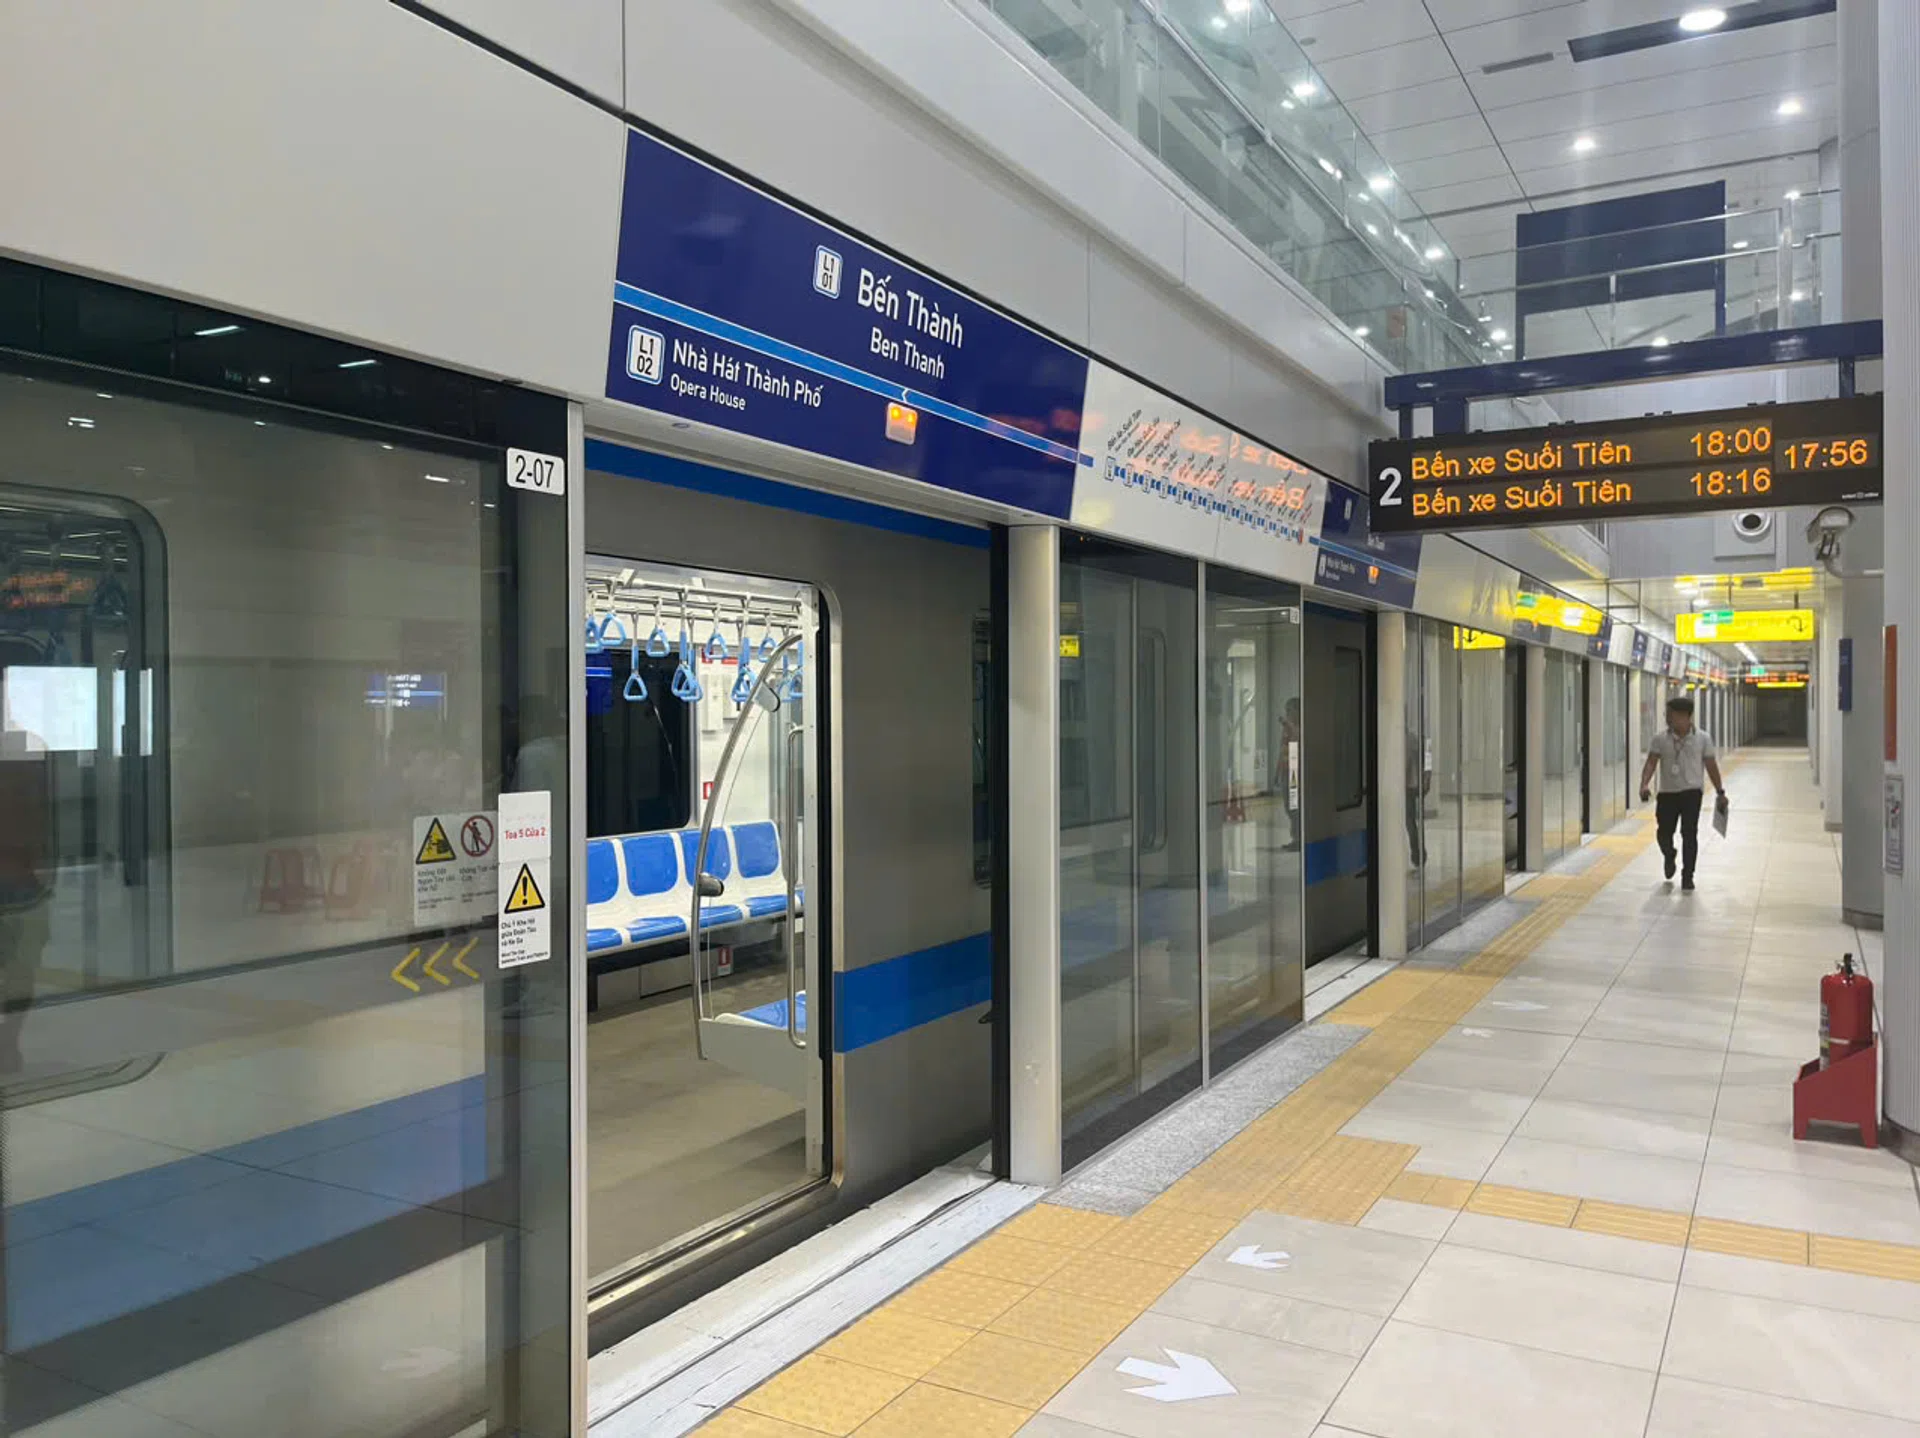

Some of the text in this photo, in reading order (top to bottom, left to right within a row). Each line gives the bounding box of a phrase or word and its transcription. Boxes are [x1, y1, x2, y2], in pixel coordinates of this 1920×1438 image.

[822, 272, 833, 290] 01
[823, 254, 835, 273] L1
[858, 268, 963, 348] Bến Thành
[639, 335, 654, 355] L1
[870, 327, 945, 379] Ben Thanh
[637, 355, 653, 375] 02
[673, 339, 824, 408] Nhà Hát Thành Phố
[670, 373, 746, 410] Opera House
[1411, 426, 1771, 480] Bến xe Suối Tiên 18:00
[1784, 439, 1868, 470] 17:56
[516, 454, 555, 489] 2-07
[1379, 467, 1402, 506] 2
[1412, 468, 1771, 516] Bến xe Suối Tiên 18:16
[541, 826, 546, 836] 2
